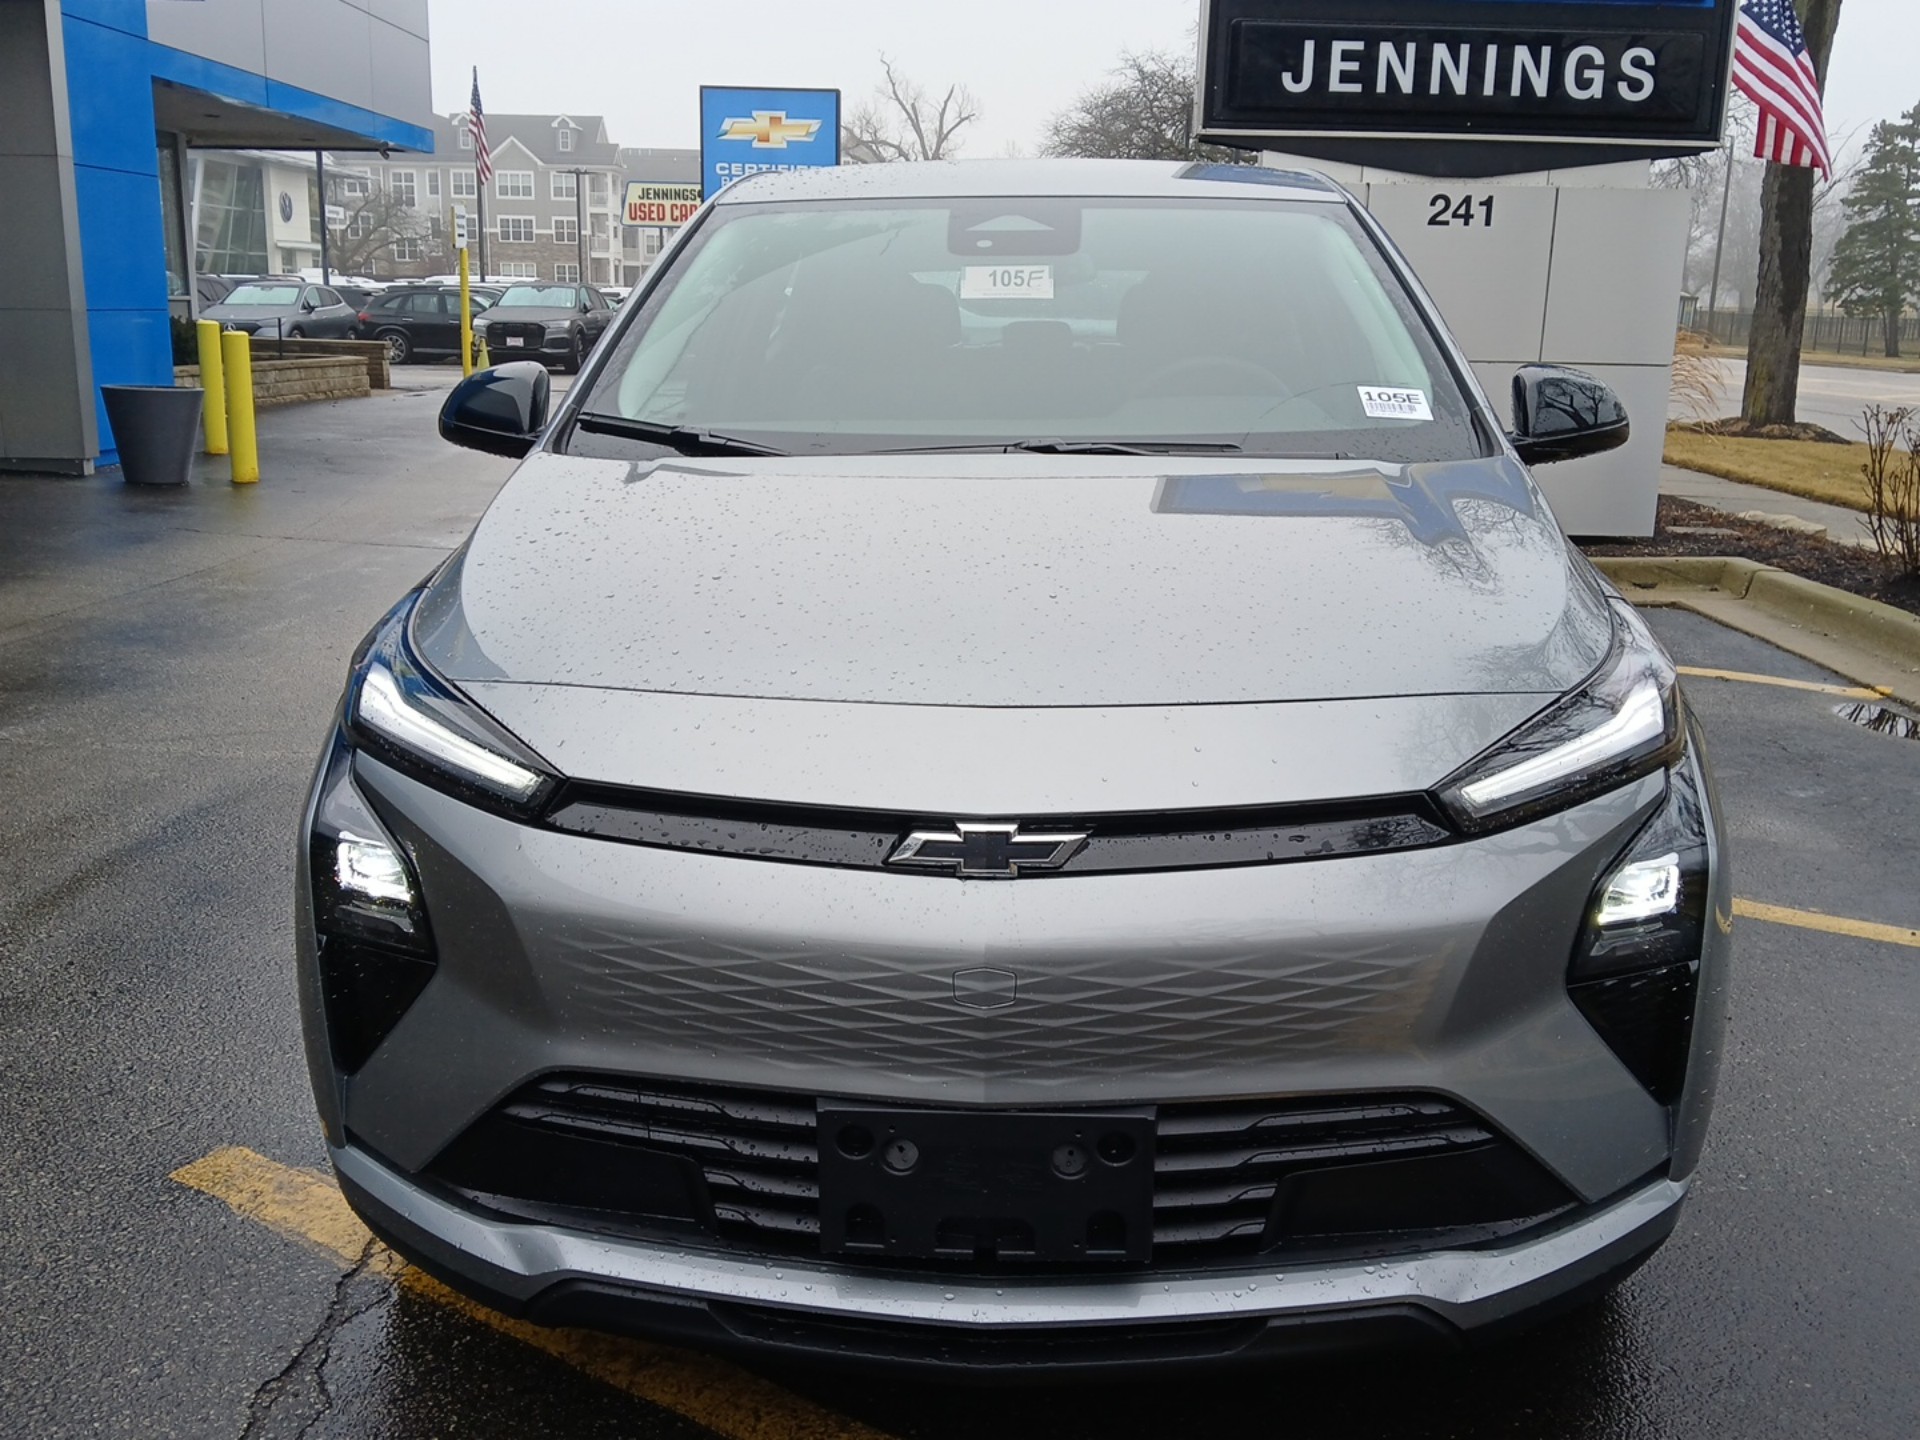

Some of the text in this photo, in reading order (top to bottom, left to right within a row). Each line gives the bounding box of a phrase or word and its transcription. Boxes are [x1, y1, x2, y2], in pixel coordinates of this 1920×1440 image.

[1281, 40, 1656, 101] JENNINGS
[628, 203, 666, 222] USED
[1427, 194, 1495, 227] 241
[1364, 391, 1422, 404] 105E
